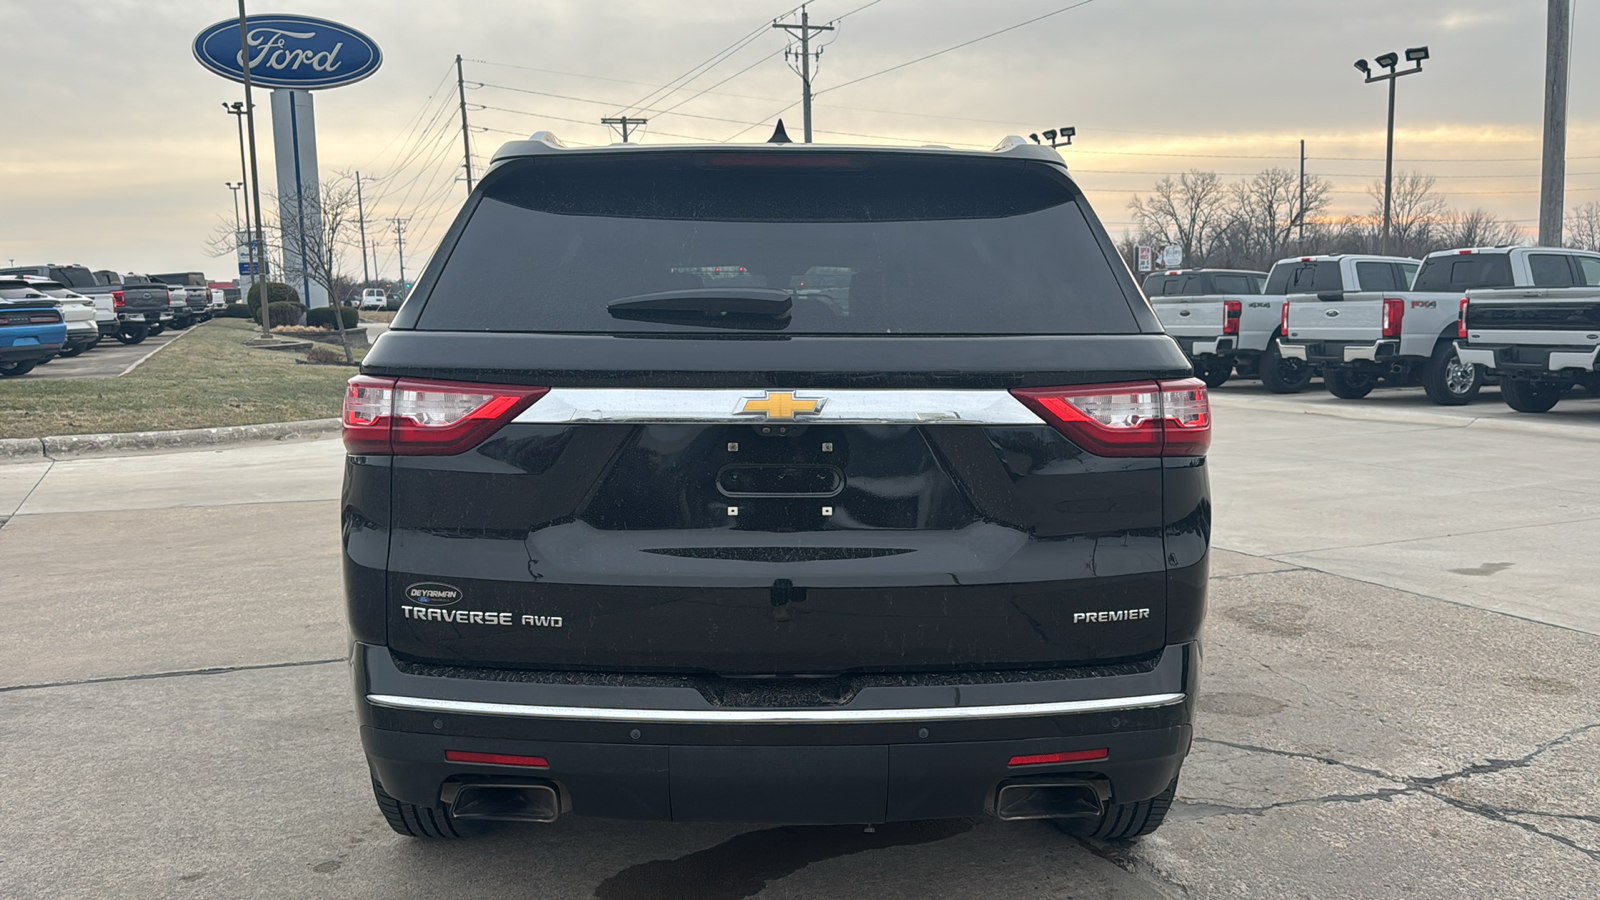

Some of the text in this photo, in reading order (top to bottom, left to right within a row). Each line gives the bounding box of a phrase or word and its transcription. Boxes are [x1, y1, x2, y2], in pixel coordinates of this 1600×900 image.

[236, 28, 343, 72] Ford
[1411, 300, 1436, 308] FX4
[410, 589, 456, 598] DEYARMAN
[401, 605, 562, 627] TRAVERSE AWD
[1073, 608, 1150, 623] PREMIER
